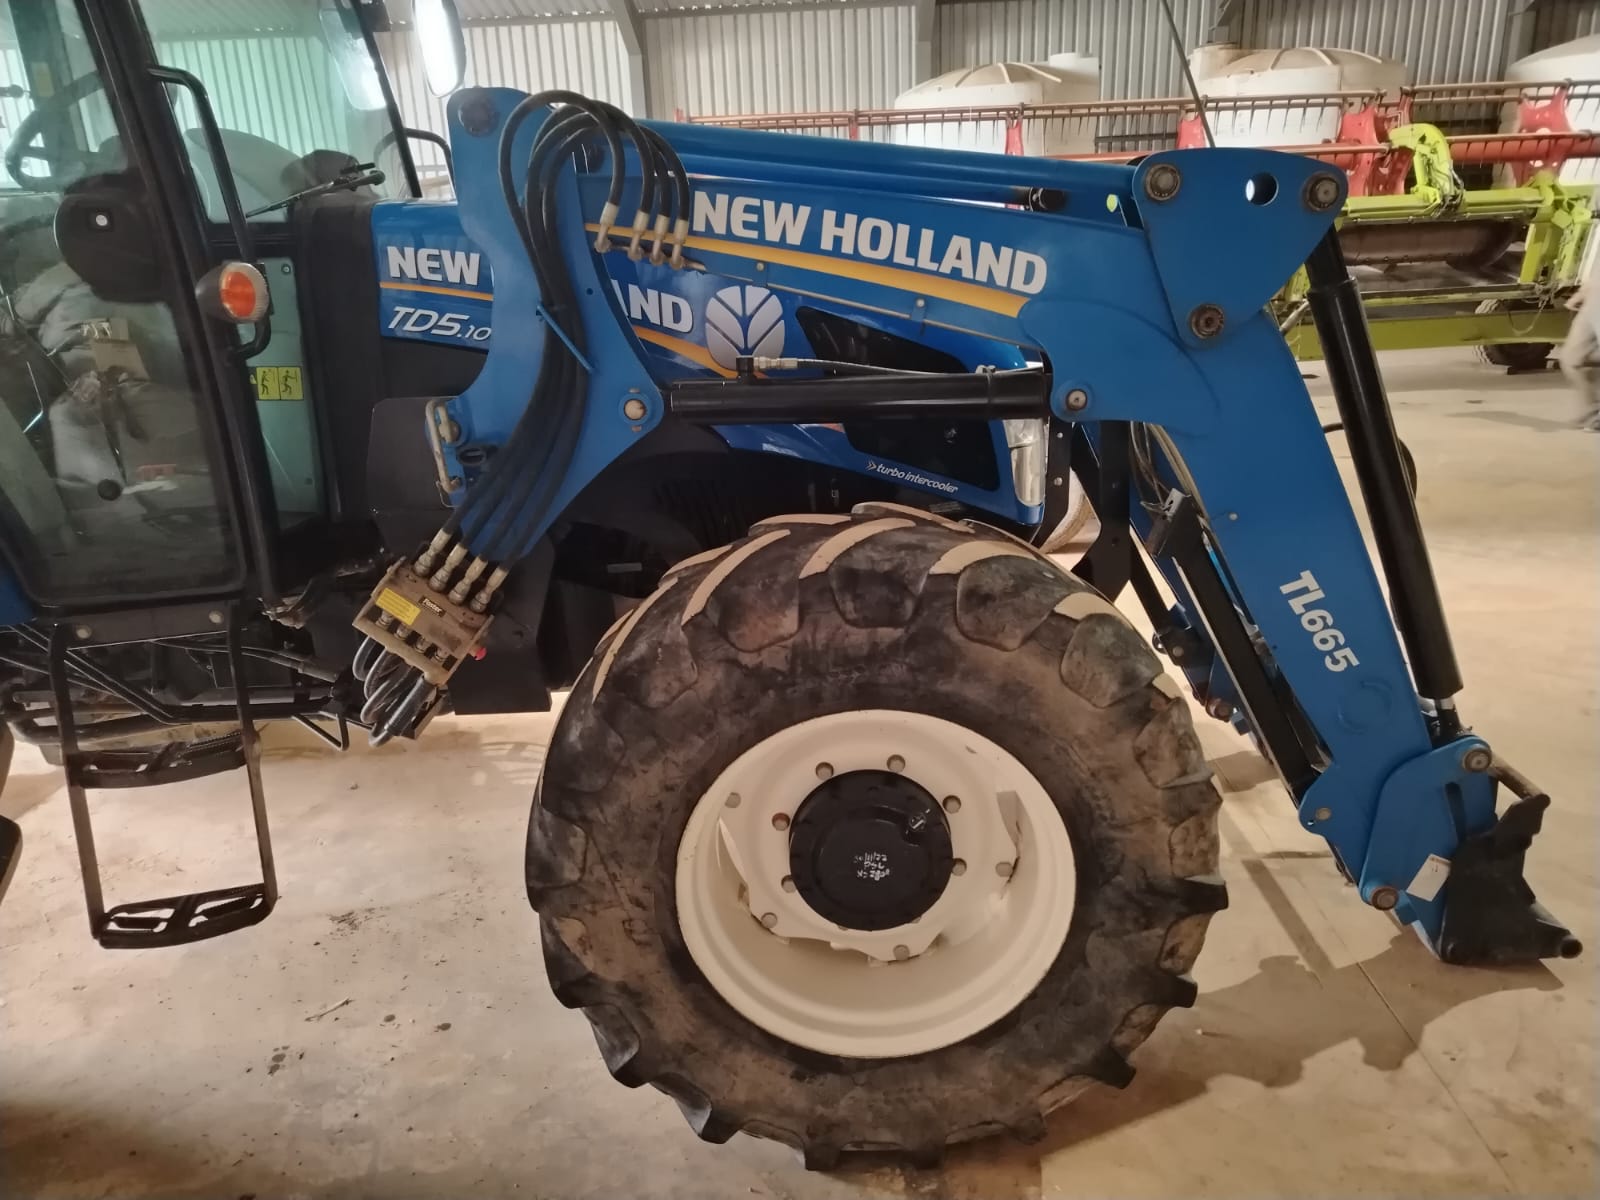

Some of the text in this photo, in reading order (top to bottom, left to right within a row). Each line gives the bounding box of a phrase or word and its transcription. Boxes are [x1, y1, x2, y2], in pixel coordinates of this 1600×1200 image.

[387, 246, 480, 286] NEW
[693, 191, 1047, 295] NEW HOLLAND
[876, 463, 959, 493] turbo intercooler
[1279, 569, 1360, 672] TL665
